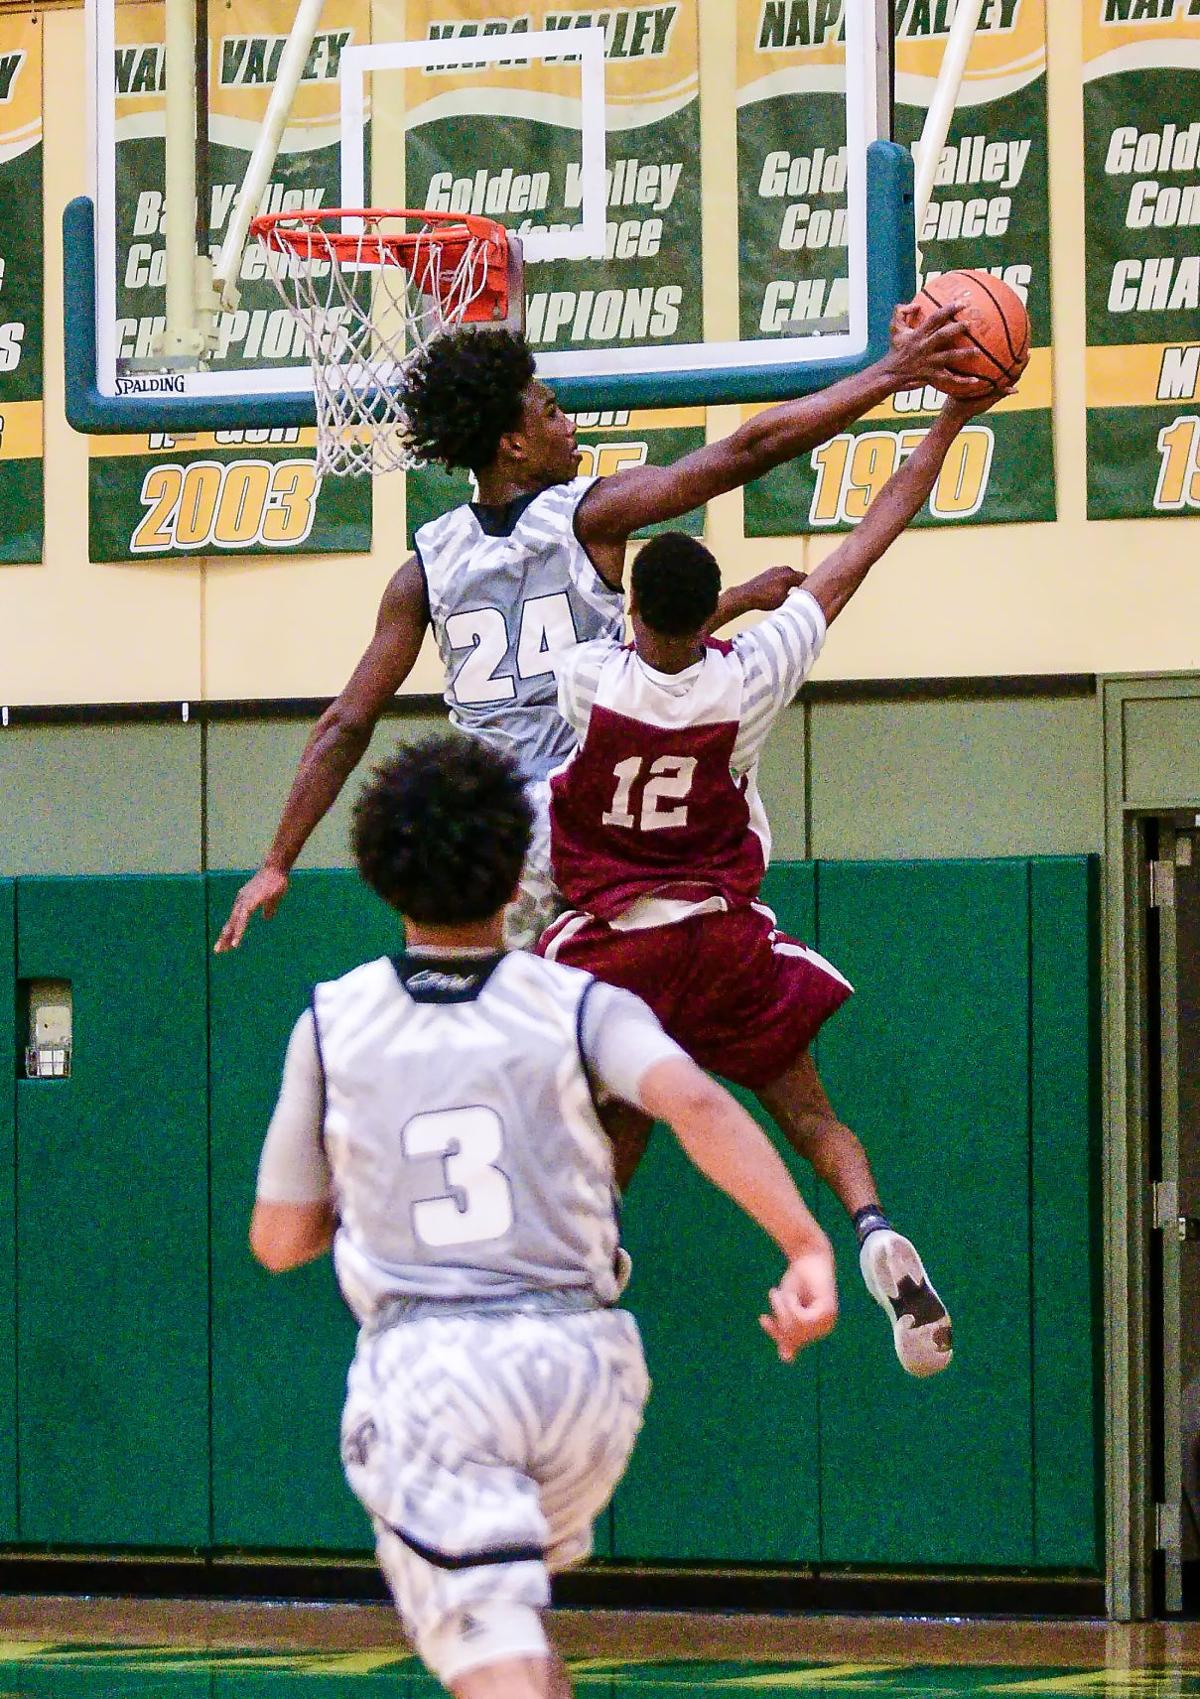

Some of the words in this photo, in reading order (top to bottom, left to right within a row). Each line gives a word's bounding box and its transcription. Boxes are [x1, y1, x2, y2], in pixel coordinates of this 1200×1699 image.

[759, 0, 846, 48] NAP
[222, 33, 350, 83] VALEY
[758, 146, 848, 197] Gold
[1105, 123, 1200, 174] Gold
[425, 168, 550, 214] Golden
[565, 159, 683, 211] Vlley
[526, 285, 683, 343] MPIONS
[115, 375, 184, 396] SPALDING
[131, 460, 320, 552] 2003
[445, 591, 581, 704] 24
[602, 755, 698, 832] 12
[402, 1104, 514, 1247] 3
